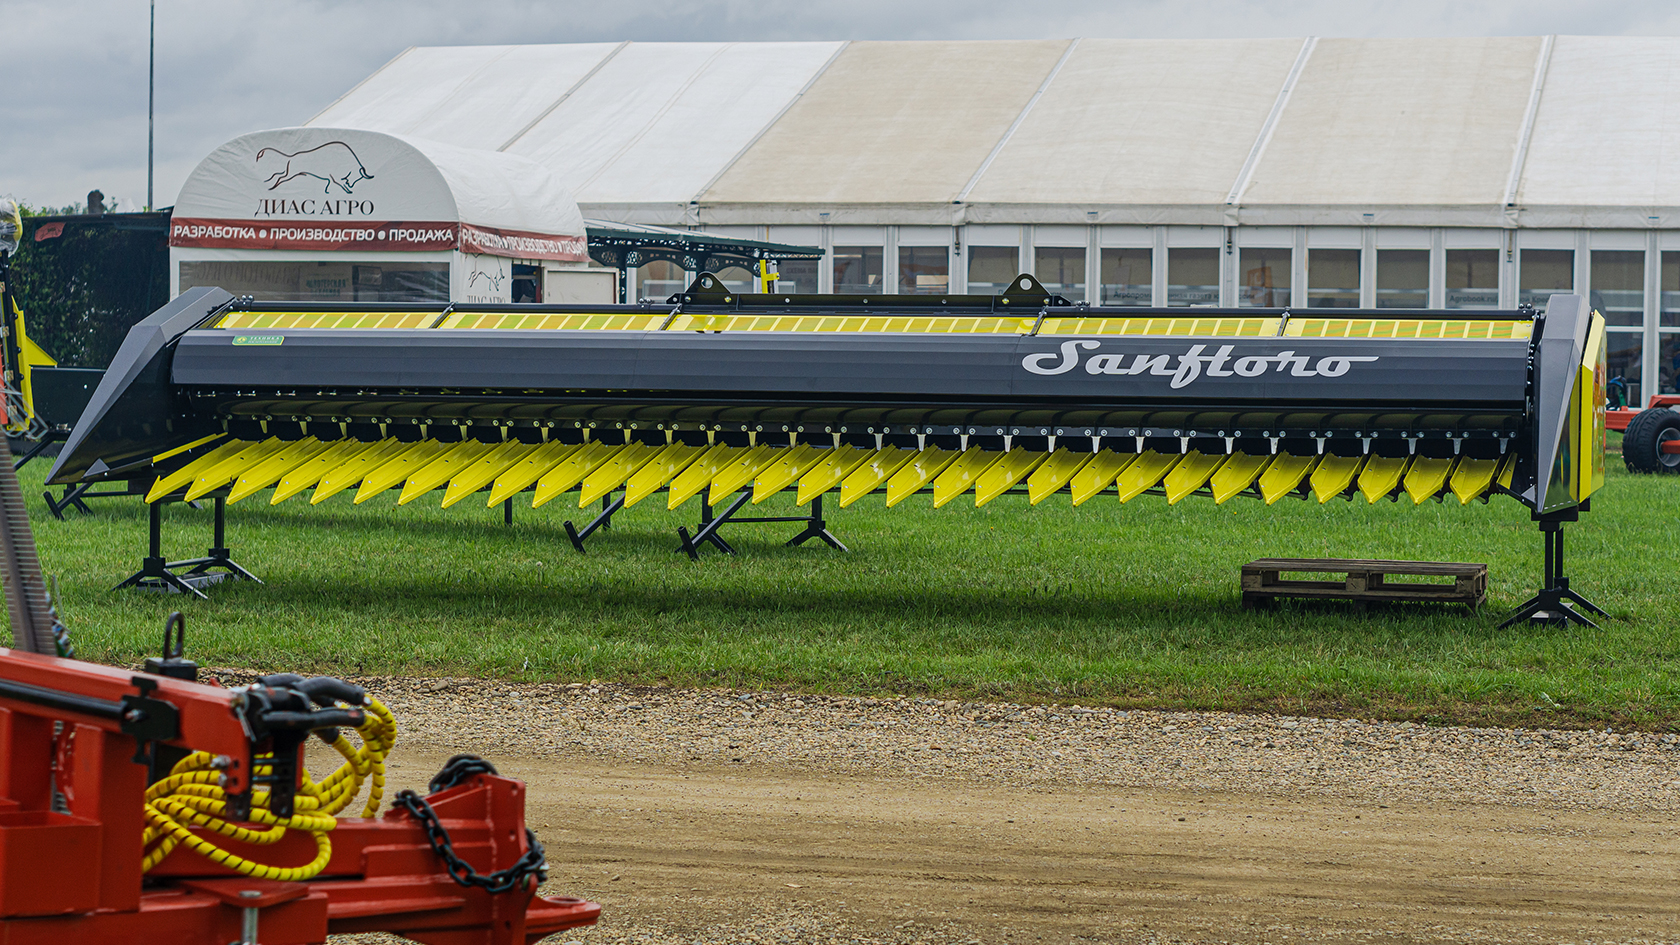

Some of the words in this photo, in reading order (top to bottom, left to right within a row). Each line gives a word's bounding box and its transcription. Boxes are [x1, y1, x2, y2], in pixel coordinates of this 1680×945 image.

[254, 199, 315, 217] ДИАС
[320, 199, 374, 216] АГРО
[173, 225, 256, 240] РАЗРАБОТКА
[269, 228, 374, 242] ПРОИЗВОДСТВО
[388, 229, 454, 243] ПРОДАЖА
